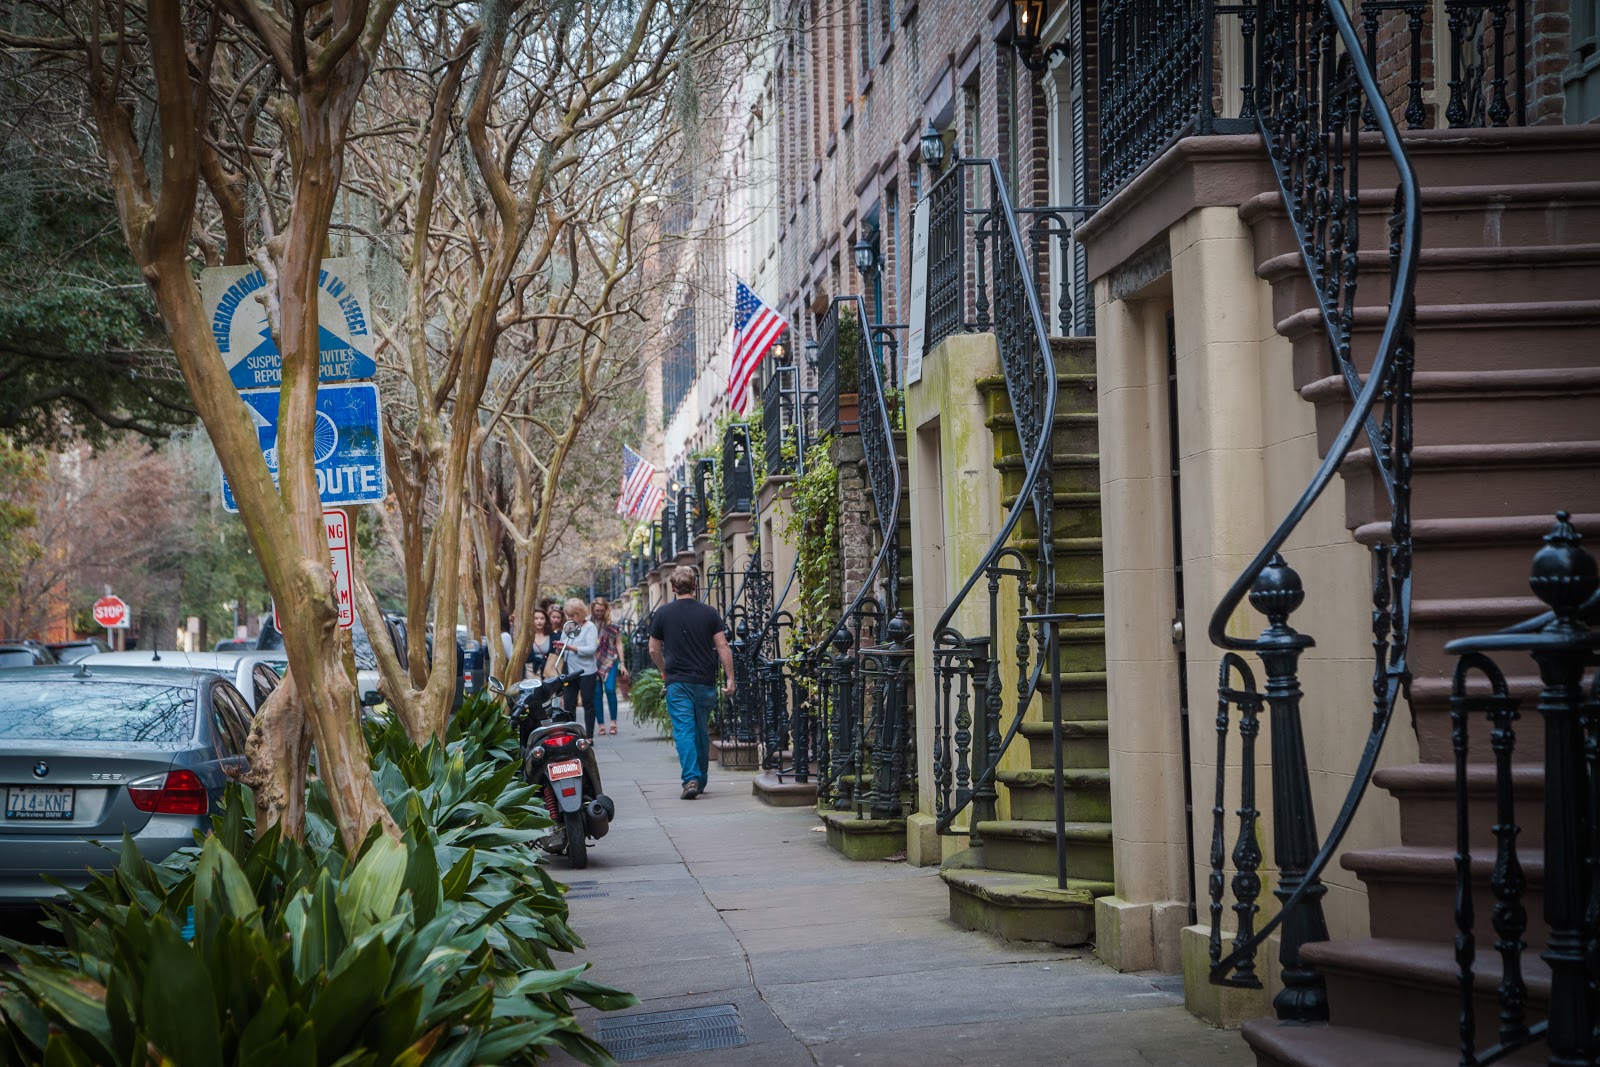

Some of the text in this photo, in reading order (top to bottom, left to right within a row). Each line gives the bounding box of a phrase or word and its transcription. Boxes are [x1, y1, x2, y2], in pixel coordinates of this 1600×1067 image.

[212, 270, 266, 353] NEIGHBORHOO
[325, 276, 347, 299] IN
[338, 293, 368, 337] EFFECT
[247, 355, 282, 370] SUSPIC
[96, 605, 123, 618] STOP
[11, 794, 71, 811] 714 KNF
